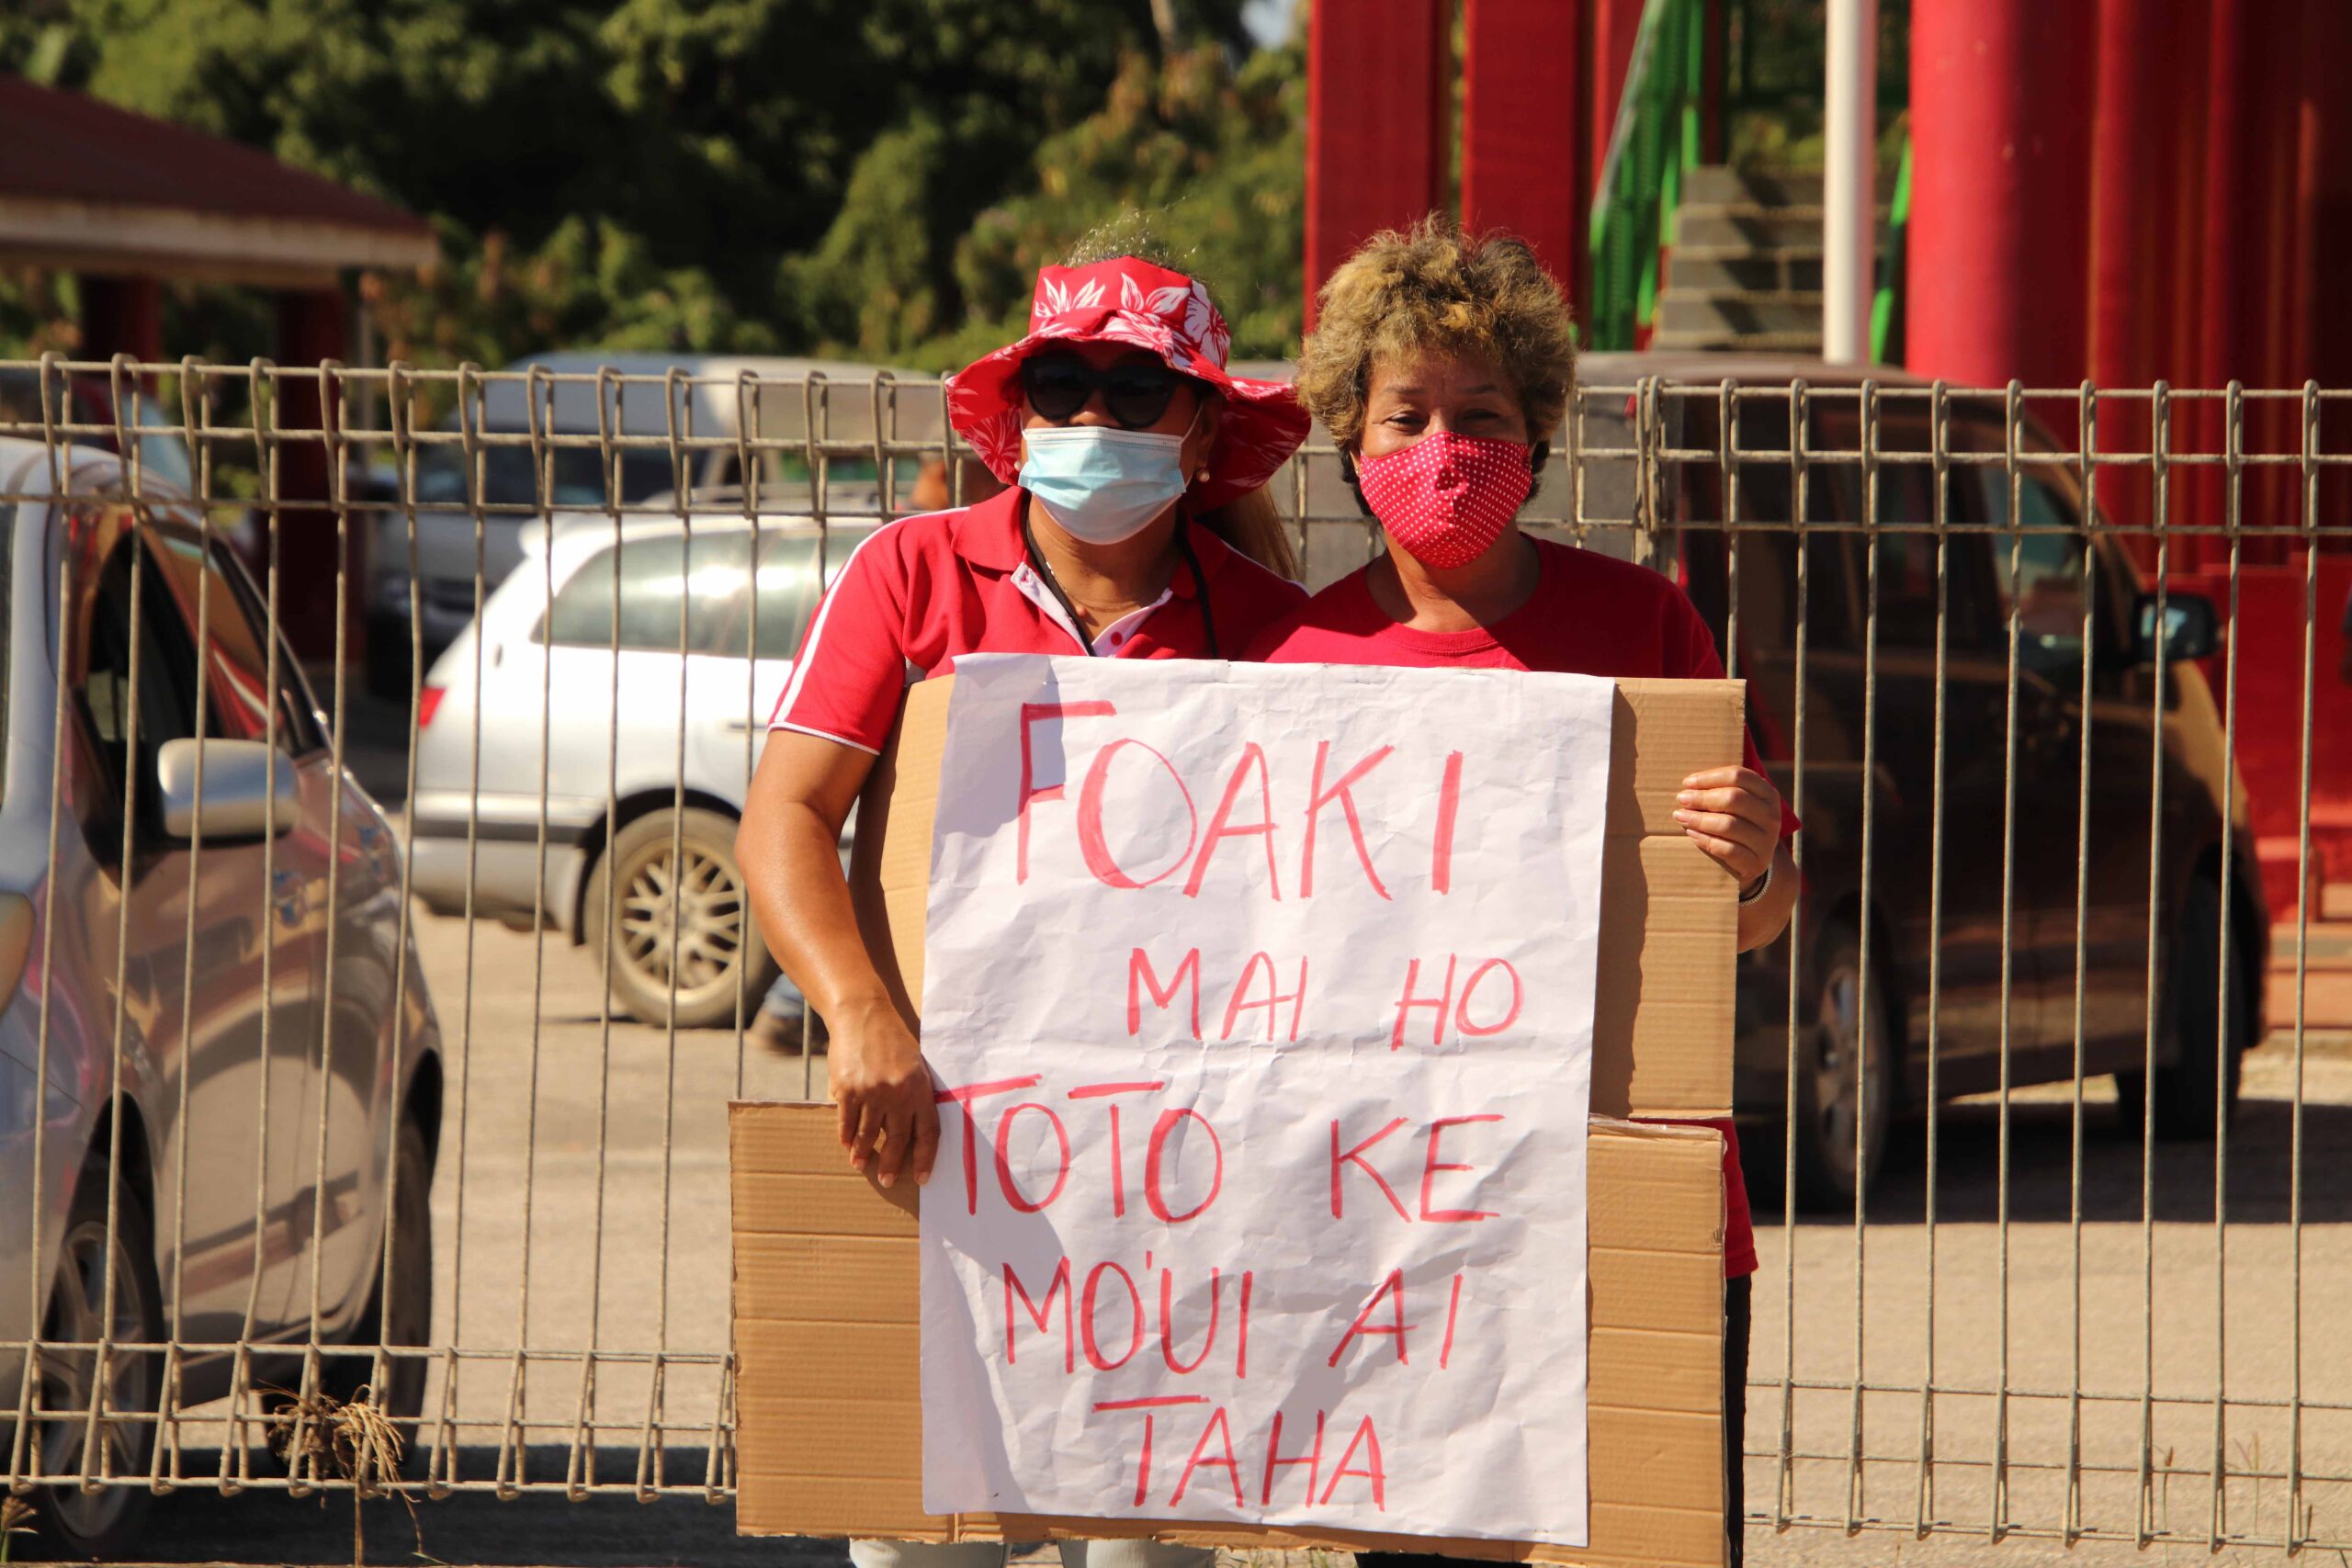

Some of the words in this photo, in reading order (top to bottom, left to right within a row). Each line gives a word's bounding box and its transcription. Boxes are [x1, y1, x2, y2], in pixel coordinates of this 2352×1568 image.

[1016, 699, 1464, 902] FOAKI
[1125, 946, 1309, 1043] MAI
[1389, 952, 1525, 1054] HO
[935, 1073, 1224, 1224] TOTO
[1329, 1112, 1507, 1224] KE
[1327, 1266, 1465, 1371] AI
[1091, 1393, 1387, 1513] TAHA
